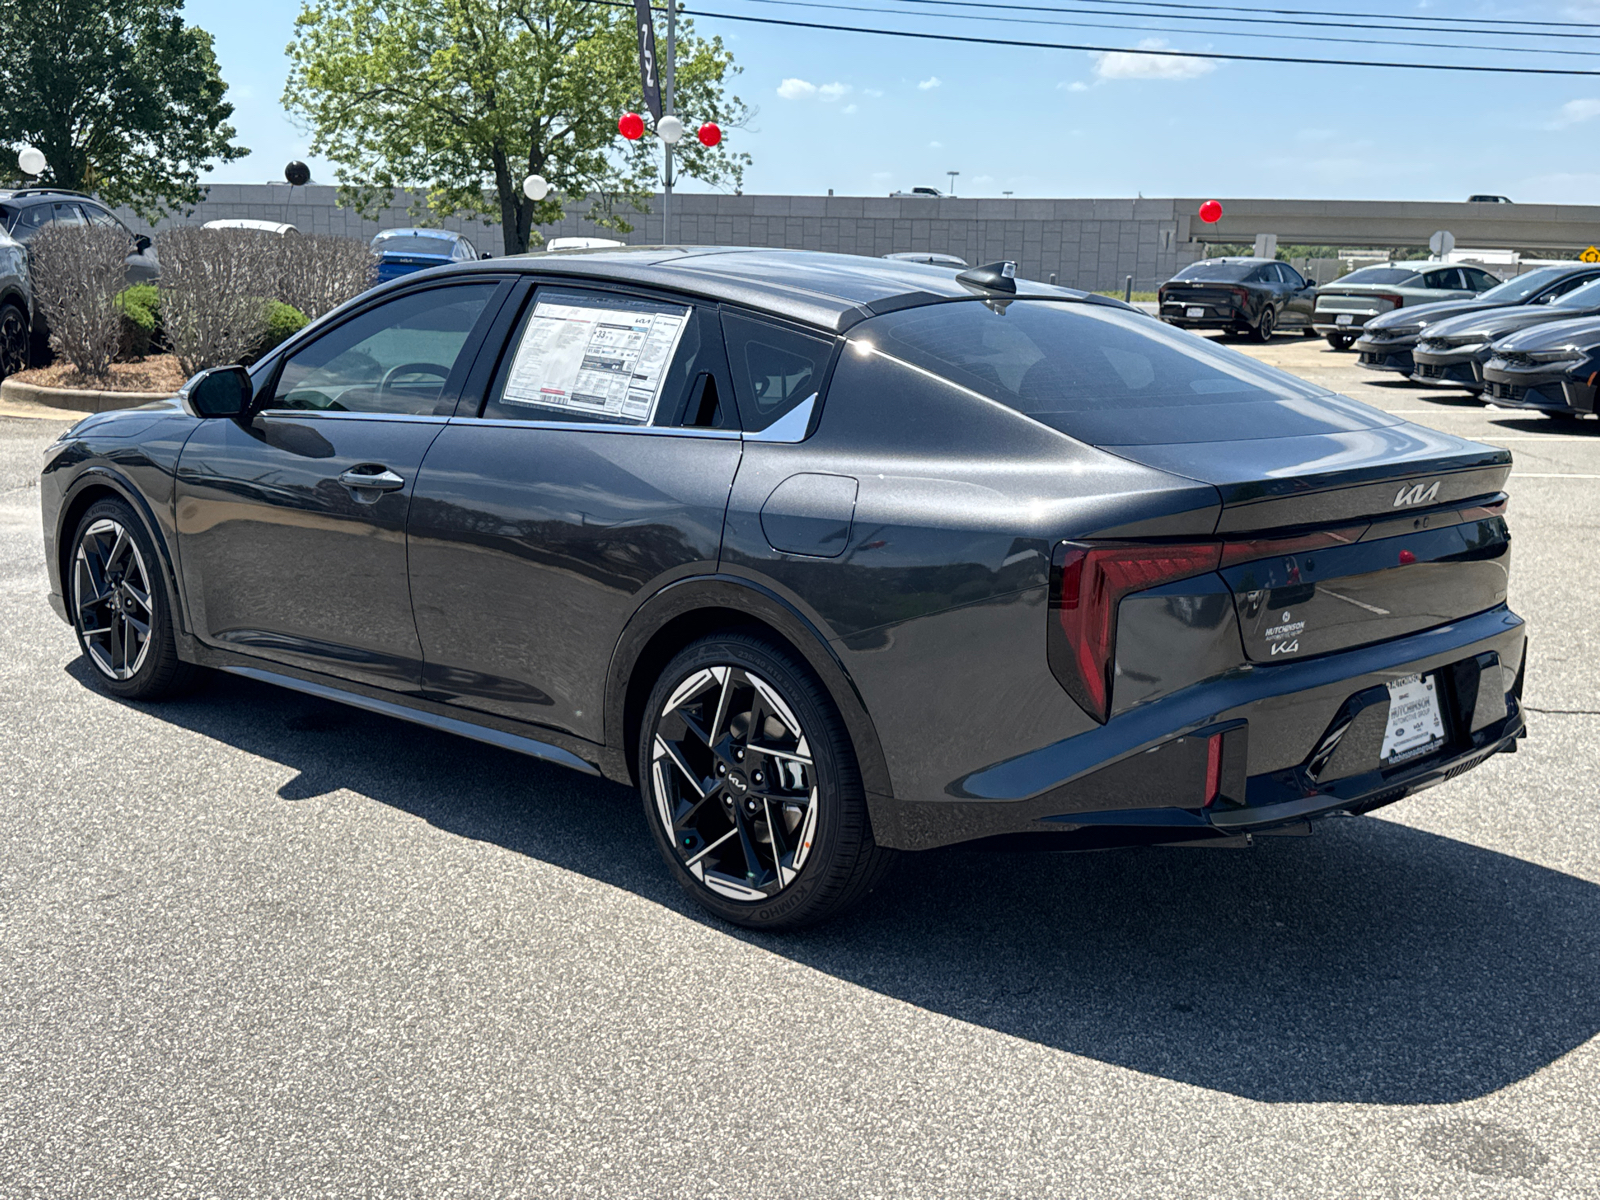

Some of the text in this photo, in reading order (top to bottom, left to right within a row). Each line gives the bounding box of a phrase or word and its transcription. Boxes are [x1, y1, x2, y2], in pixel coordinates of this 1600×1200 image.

[1393, 481, 1440, 507] KIA
[1265, 620, 1305, 636] HUTCHINSON
[1271, 639, 1299, 655] K4
[728, 773, 746, 791] KIA
[759, 886, 808, 920] KUMHO
